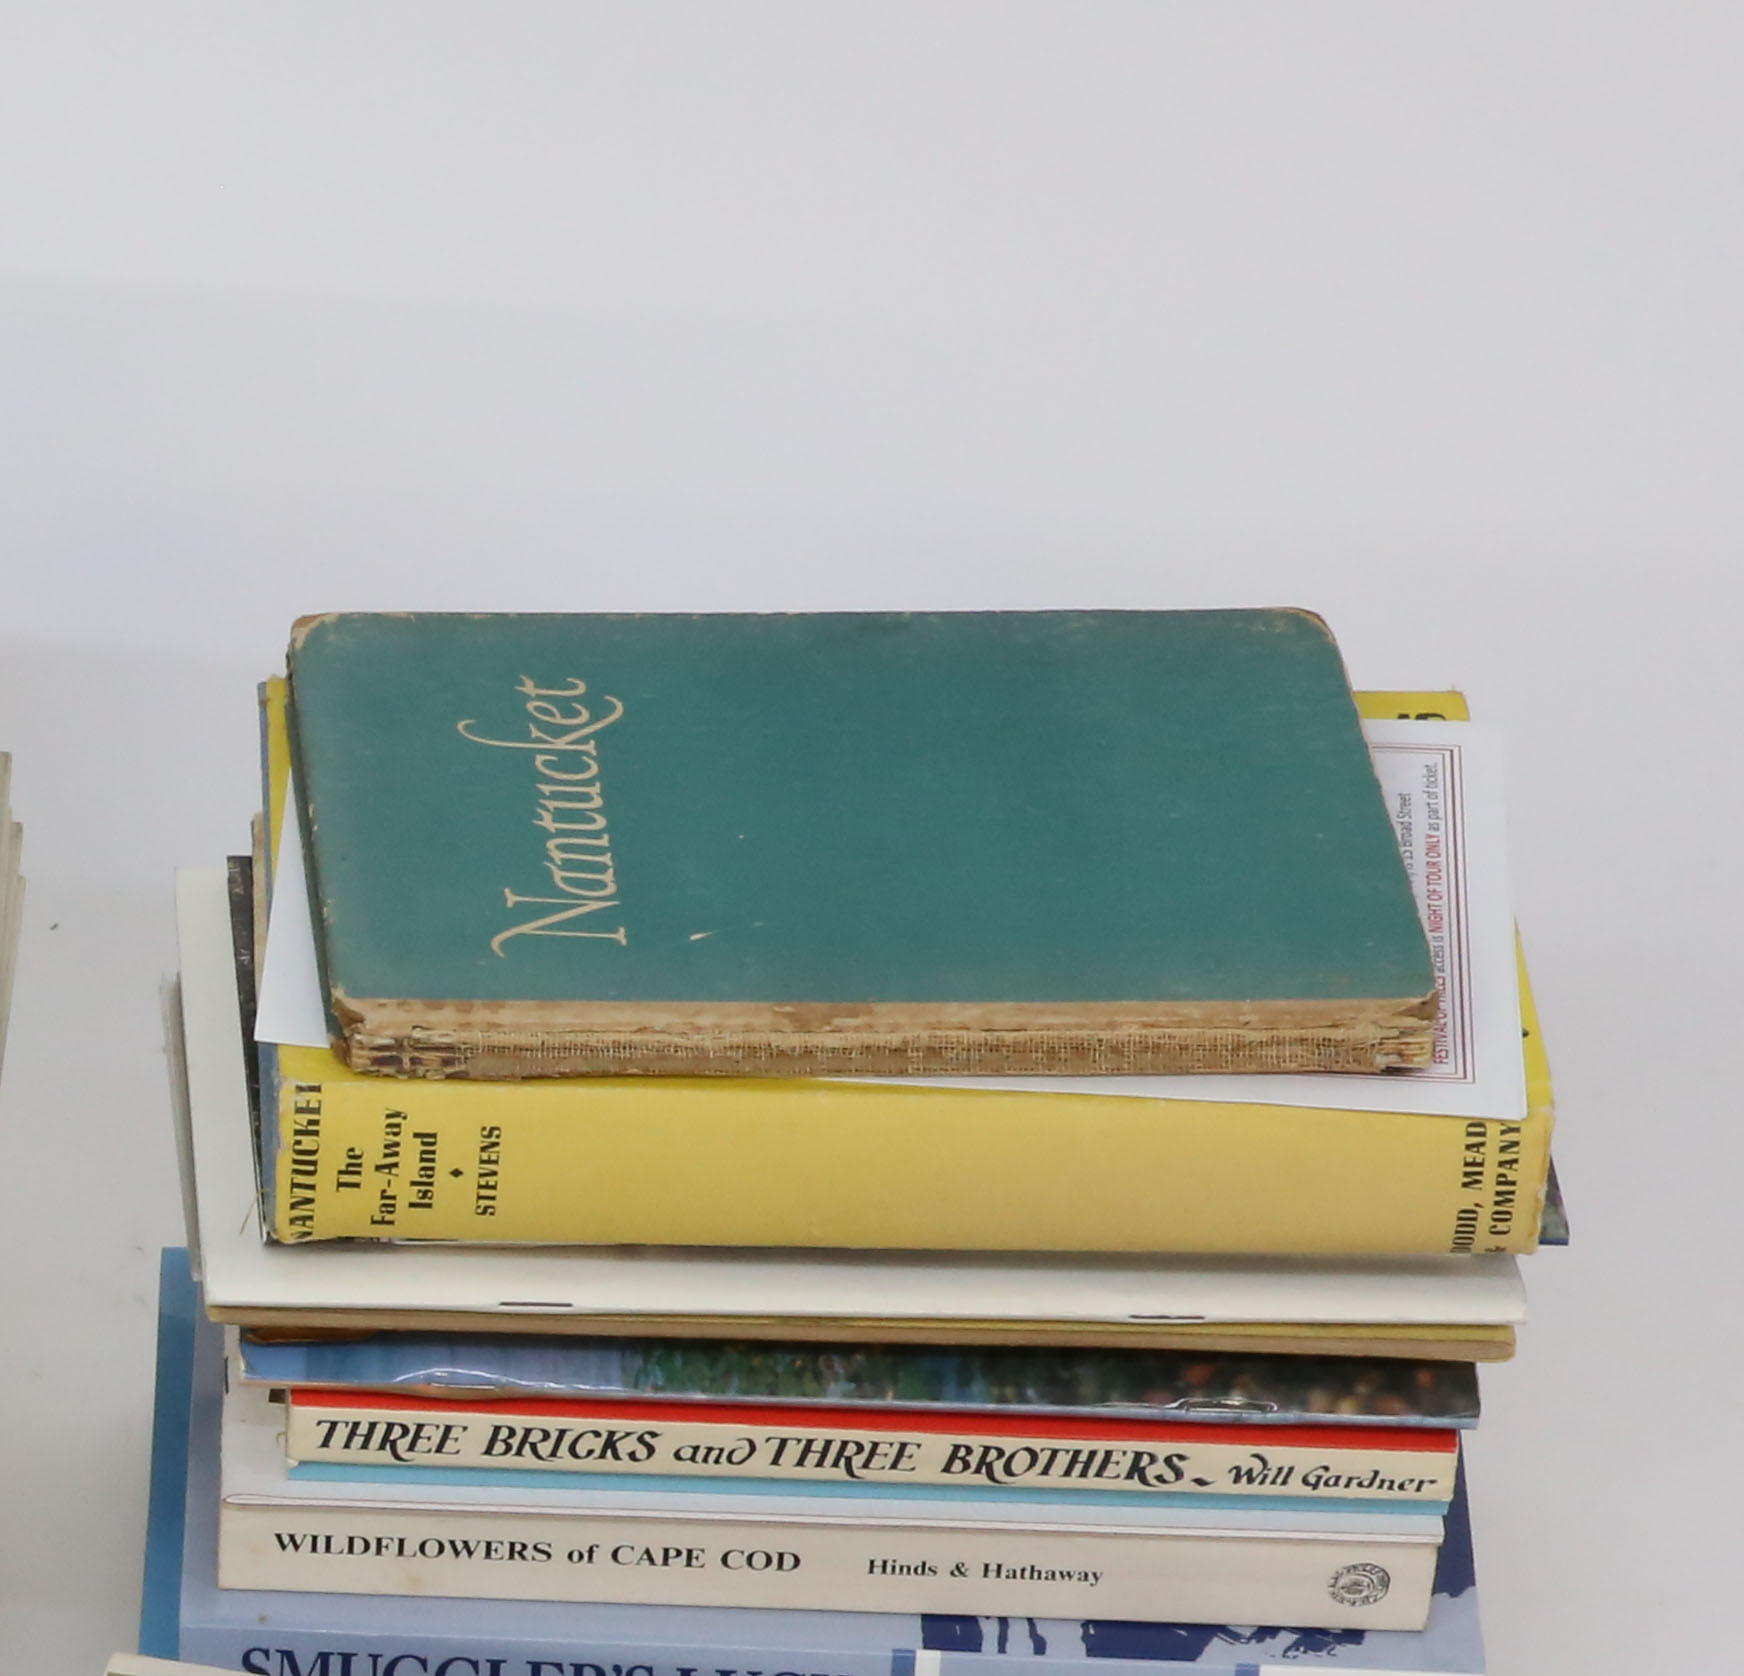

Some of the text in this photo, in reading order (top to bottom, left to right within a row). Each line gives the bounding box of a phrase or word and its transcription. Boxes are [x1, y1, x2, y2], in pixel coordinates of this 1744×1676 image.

[457, 675, 627, 958] Nantucket
[1395, 792, 1412, 820] Street
[1424, 833, 1443, 934] NIGHT TOUR ONLY
[336, 1147, 364, 1192] The
[370, 1107, 408, 1226] Far-Away
[408, 1132, 438, 1209] Island
[474, 1125, 502, 1216] STEVENS
[315, 1418, 469, 1464] THREE
[481, 1424, 664, 1465] BRICKS
[672, 1433, 758, 1467] and
[762, 1434, 922, 1480] THREE
[1228, 1452, 1295, 1489] Will
[1301, 1465, 1438, 1494] Gardner
[273, 1532, 1104, 1587] WILDFLOWERS CAPE COD Hinds Hathaway
